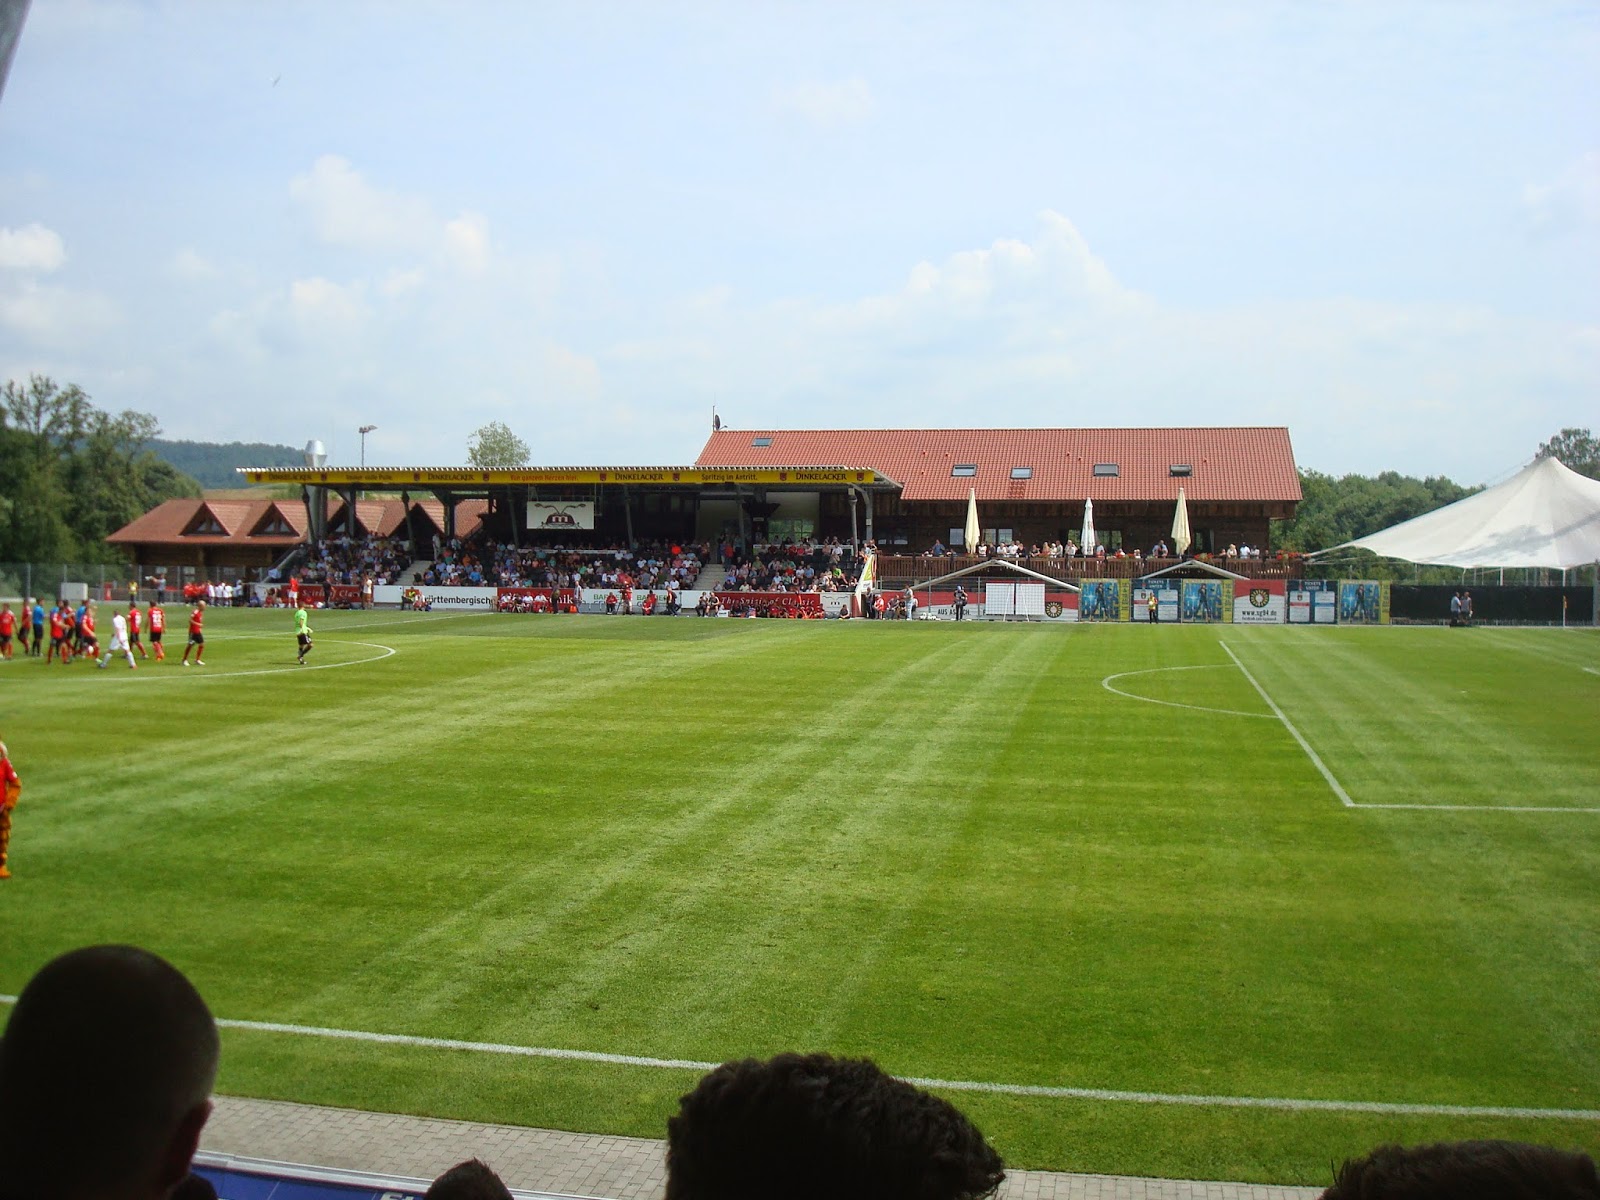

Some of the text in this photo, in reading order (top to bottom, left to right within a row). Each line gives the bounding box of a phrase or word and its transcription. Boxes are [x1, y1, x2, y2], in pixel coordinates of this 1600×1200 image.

[427, 473, 475, 481] DINKELACKER
[614, 473, 664, 481] DINKELACKER
[701, 473, 758, 483] Spritzig im Antritt.
[795, 473, 848, 481] DINKELACKER
[937, 608, 948, 616] AUS
